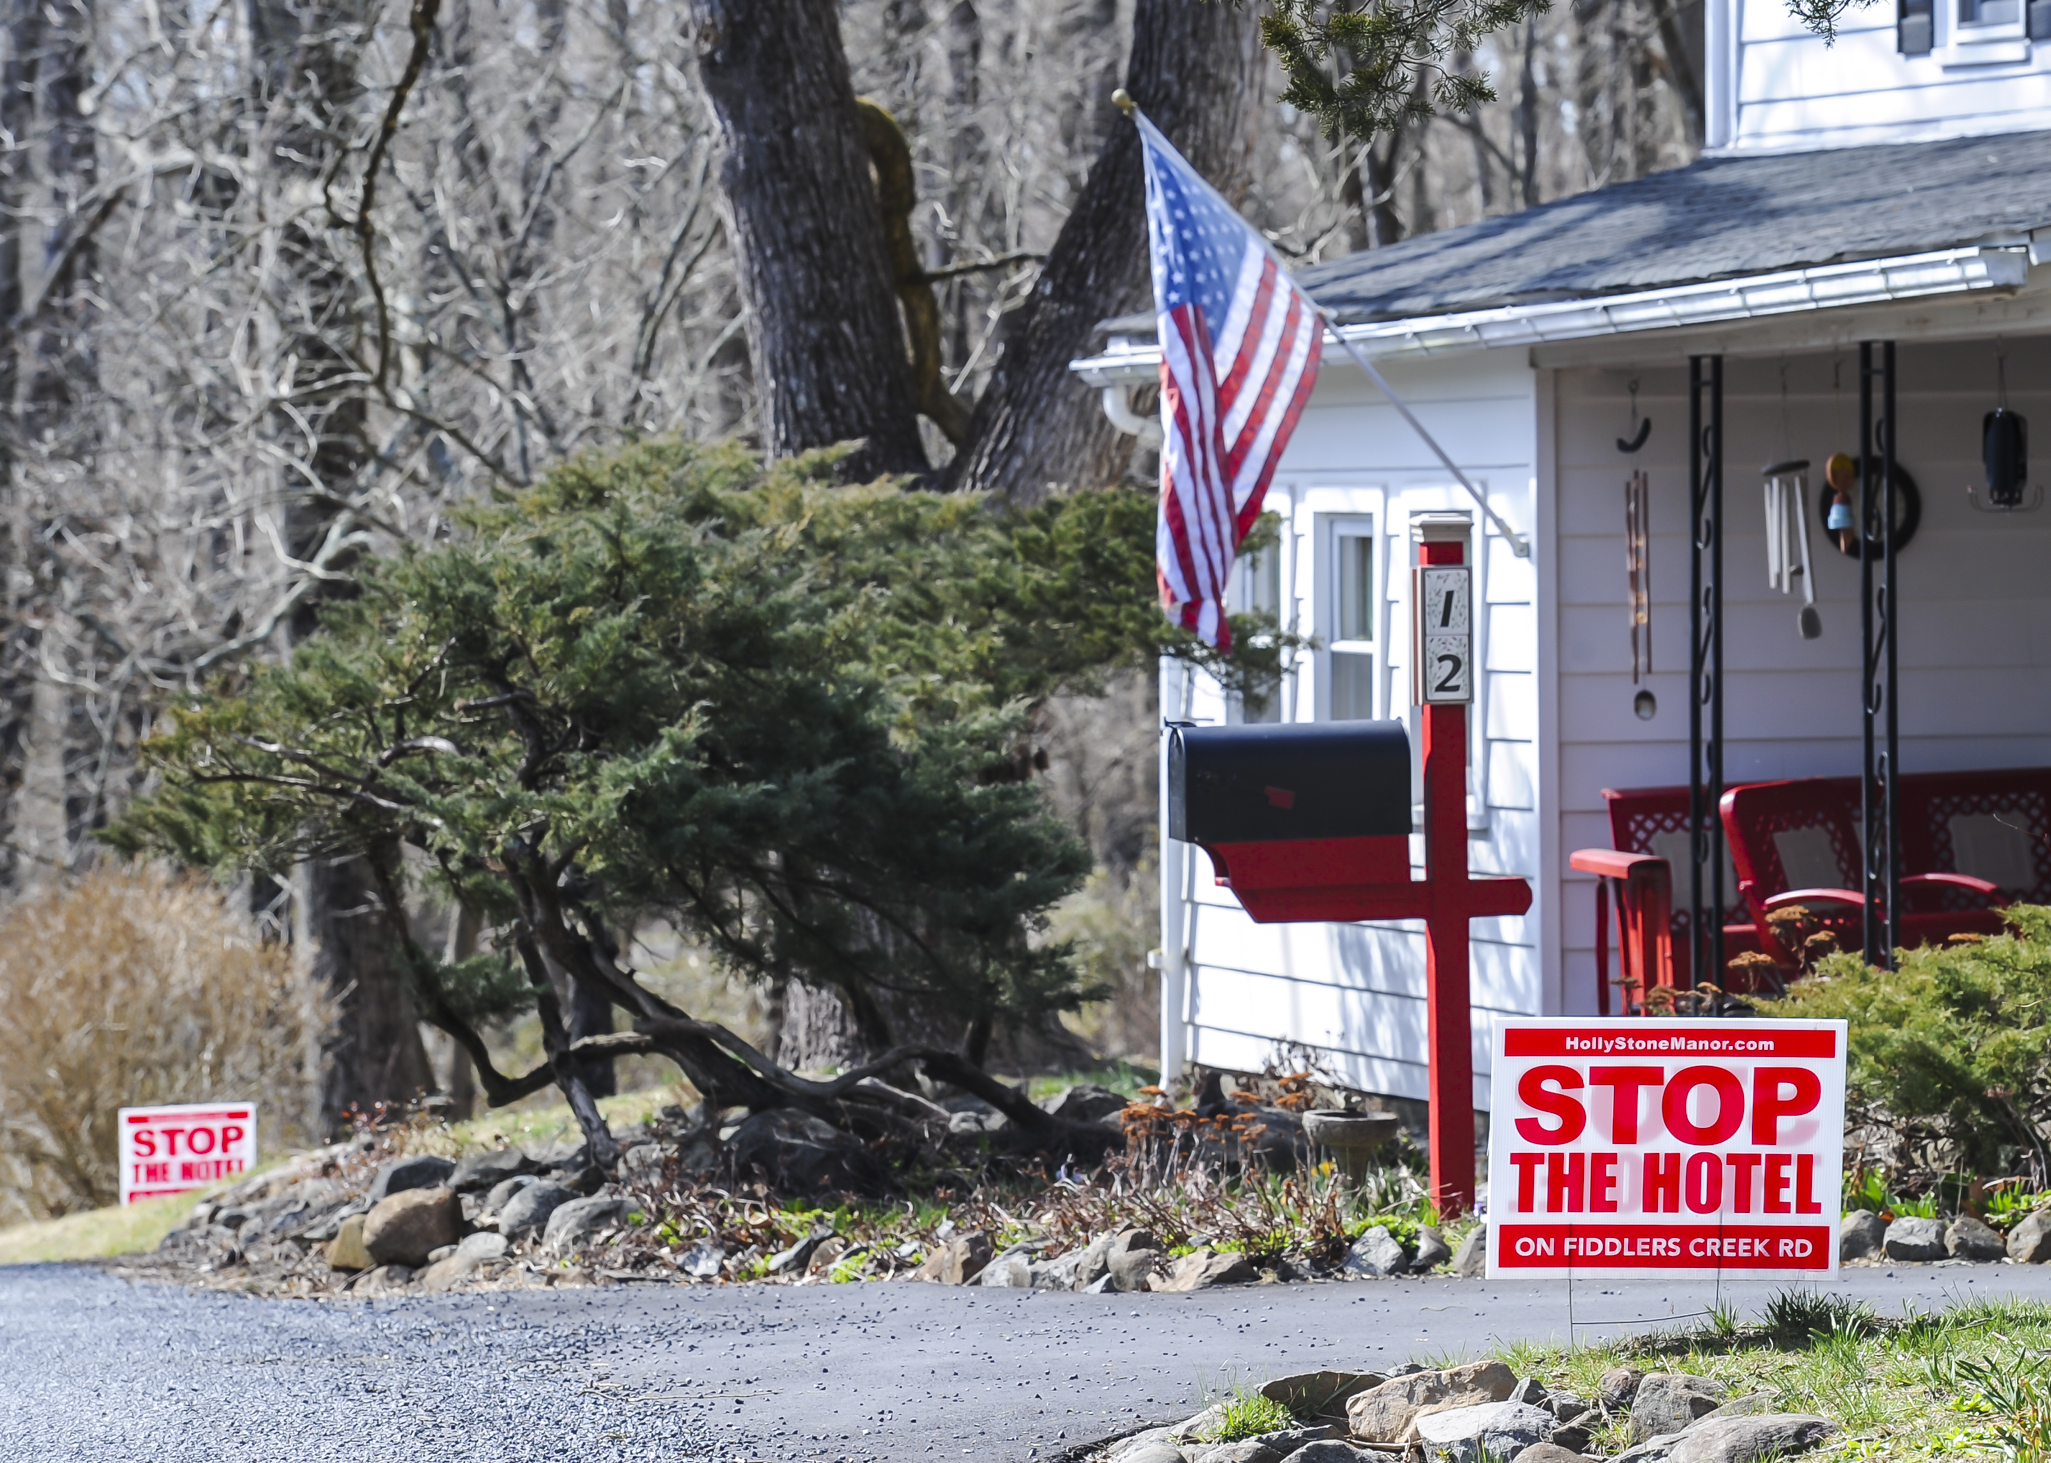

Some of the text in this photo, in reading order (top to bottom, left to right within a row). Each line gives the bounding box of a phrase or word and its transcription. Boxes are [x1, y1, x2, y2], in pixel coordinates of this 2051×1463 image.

[1565, 1036, 1775, 1053] HollyStoneManor.com
[1514, 1064, 1822, 1146] STOP
[133, 1126, 244, 1157] STOP
[134, 1162, 169, 1183] THE
[1510, 1151, 1822, 1214] THE HOTEL
[1515, 1237, 1813, 1258] ON FIDDLERS CREEK RD
